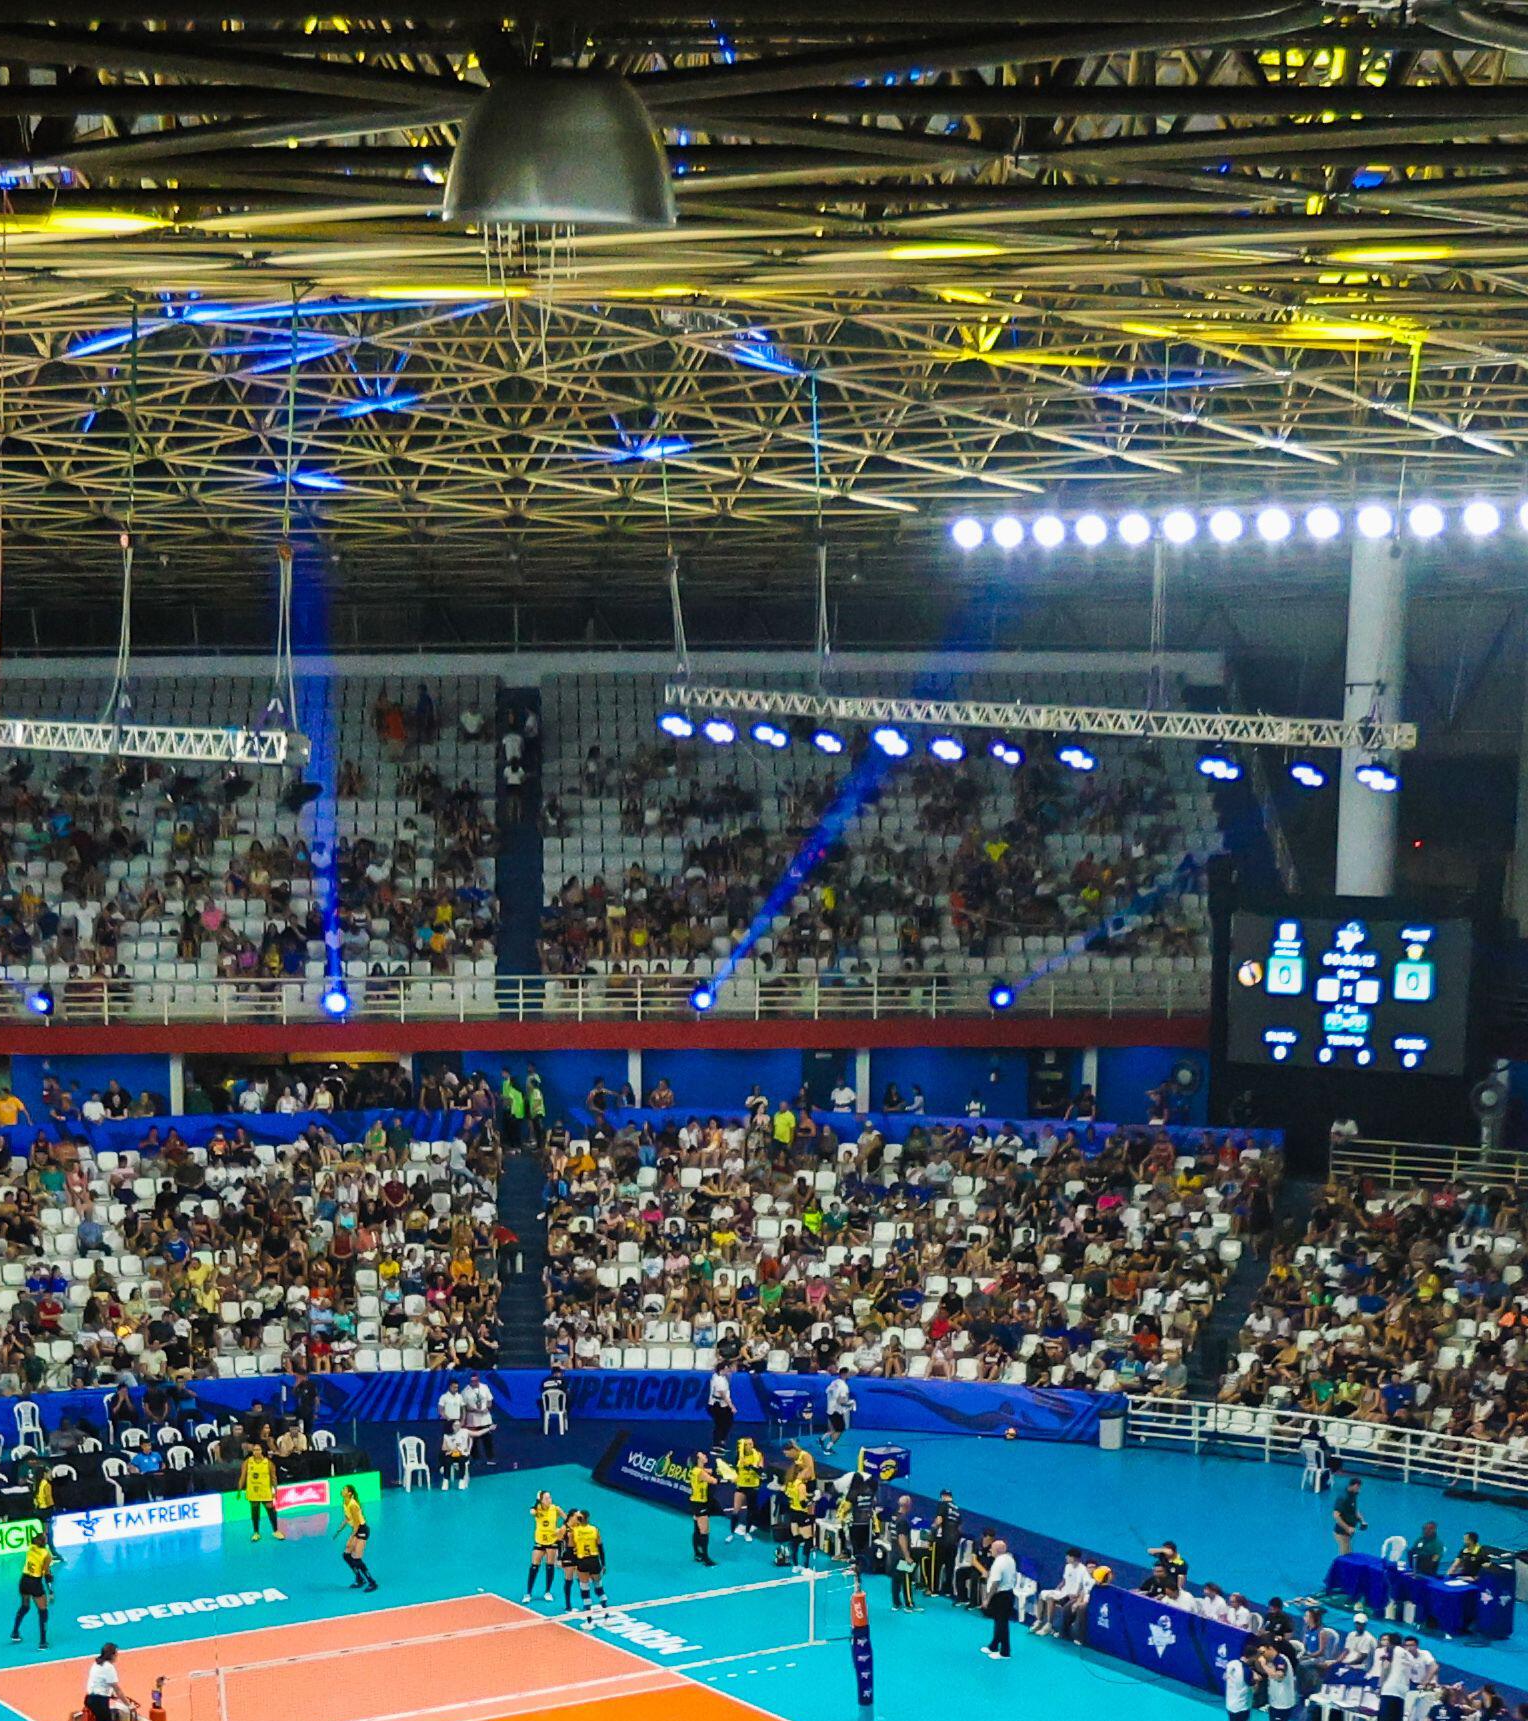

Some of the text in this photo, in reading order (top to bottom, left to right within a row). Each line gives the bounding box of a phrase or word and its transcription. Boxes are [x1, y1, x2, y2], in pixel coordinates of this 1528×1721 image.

[1278, 965, 1291, 984] 0
[1406, 971, 1419, 991] 0
[147, 1502, 201, 1524] FREIRE
[76, 1587, 289, 1630] SUPERCOPA
